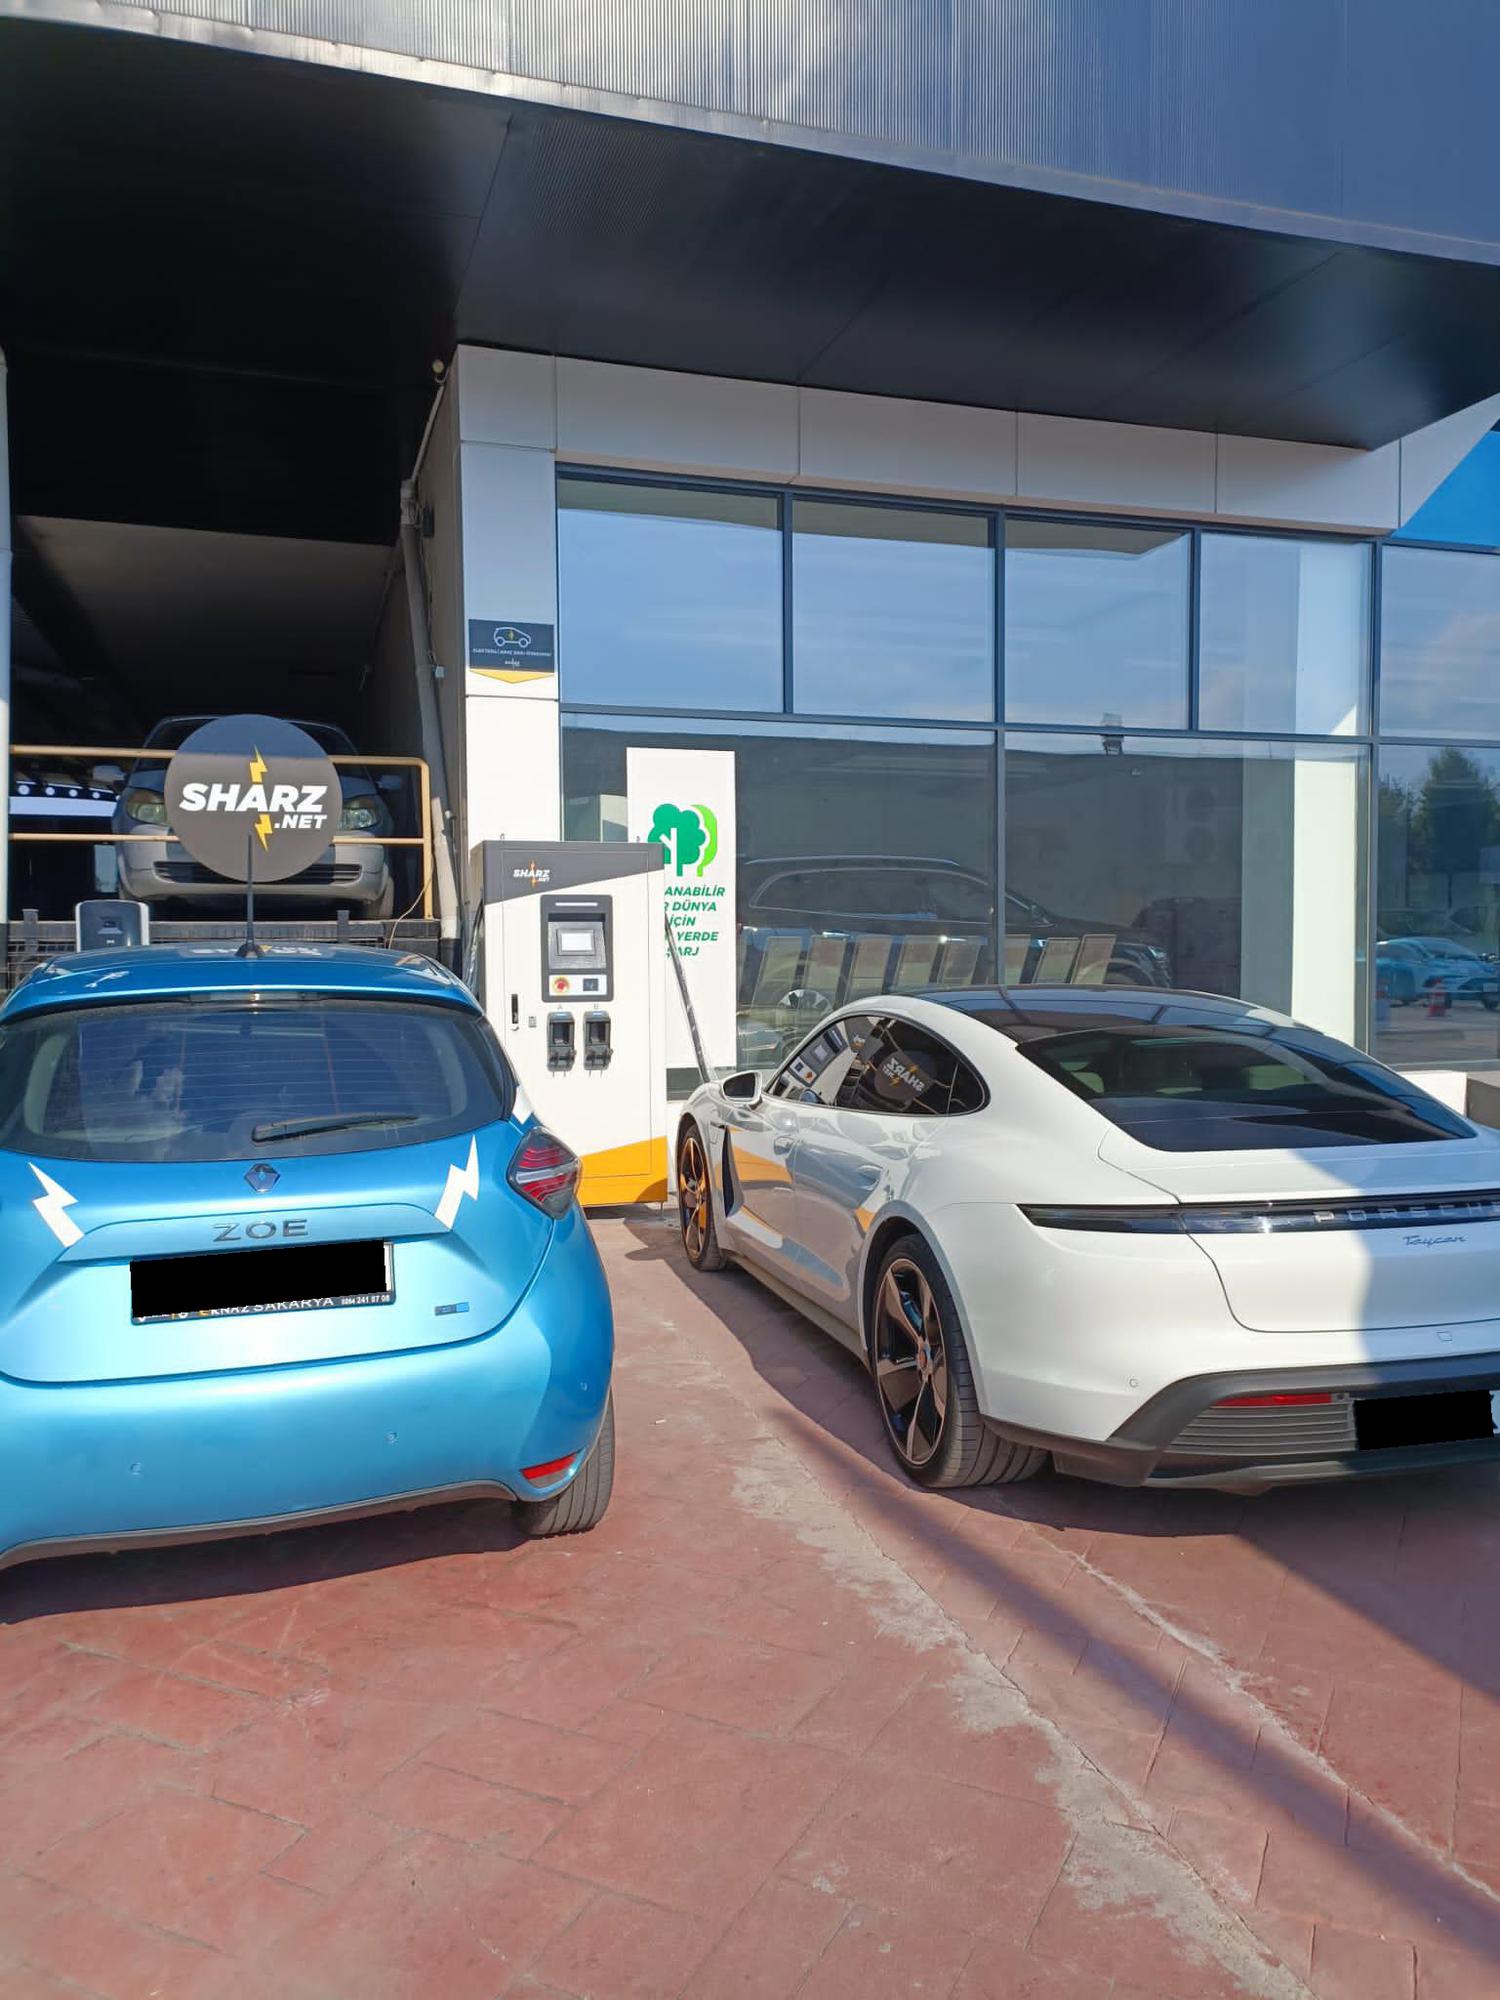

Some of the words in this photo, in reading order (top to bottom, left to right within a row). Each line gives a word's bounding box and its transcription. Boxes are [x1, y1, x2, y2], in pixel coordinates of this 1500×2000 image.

[179, 782, 328, 812] SHARZ
[274, 814, 328, 829] .NET
[513, 868, 551, 878] SHARZ
[664, 883, 726, 897] ANABİLİR
[672, 899, 717, 912] DÜNYA
[669, 914, 697, 928] İÇİN
[677, 931, 719, 942] YERDE
[212, 1219, 309, 1242] ZOE
[1403, 1235, 1467, 1248] Taycan
